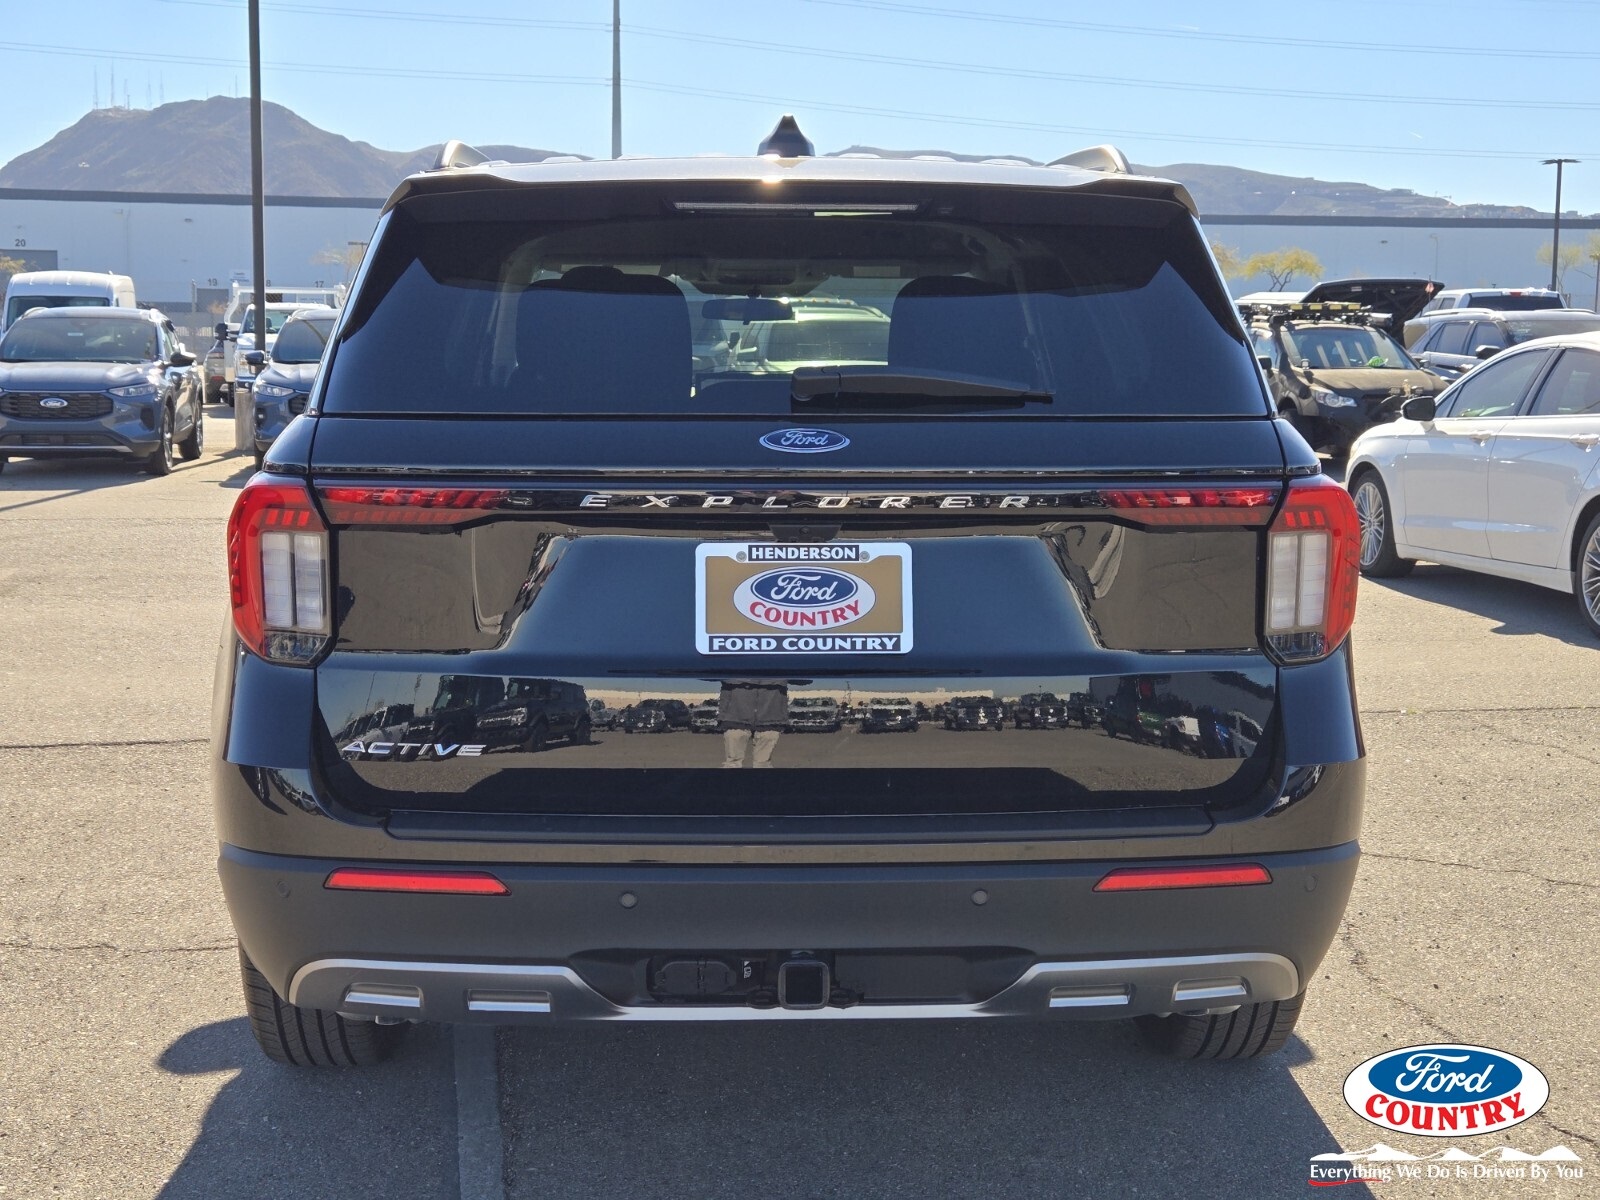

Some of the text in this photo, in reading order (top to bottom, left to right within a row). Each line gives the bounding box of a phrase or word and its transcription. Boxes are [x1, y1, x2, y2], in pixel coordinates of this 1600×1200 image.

[15, 239, 26, 247] 20
[207, 278, 217, 286] 19
[314, 280, 324, 288] 17
[780, 429, 831, 447] Ford
[579, 494, 1030, 509] EXPLORER
[751, 547, 856, 559] HENDERSON
[770, 574, 838, 601] Ford
[749, 599, 860, 627] COUNTRY
[712, 637, 898, 651] FORD COUNTRY
[341, 740, 487, 757] ACTIVE
